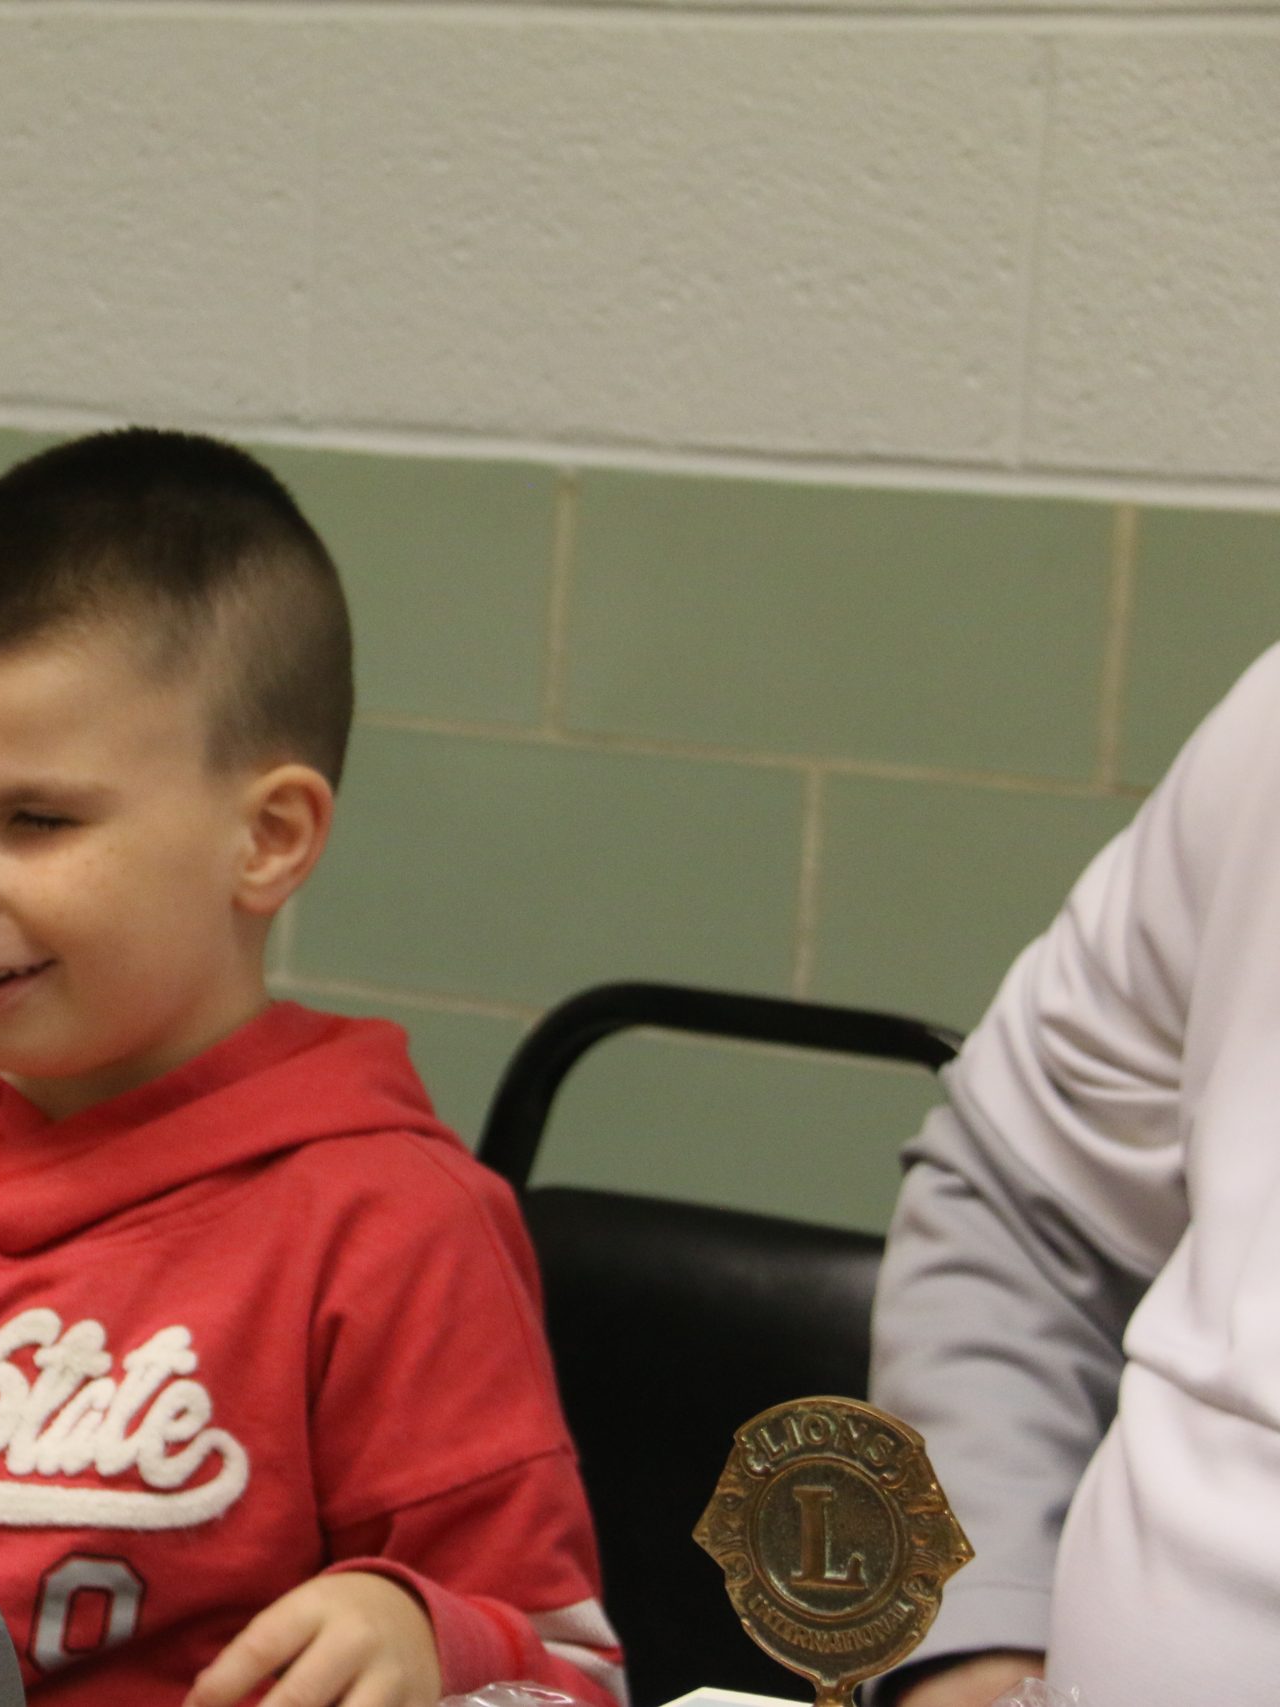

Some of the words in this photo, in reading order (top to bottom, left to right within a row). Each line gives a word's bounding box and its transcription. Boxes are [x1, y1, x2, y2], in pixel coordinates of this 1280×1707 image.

[758, 1414, 897, 1468] LIONS
[791, 1485, 866, 1589] L
[750, 1594, 915, 1653] INTERNATIONAL
